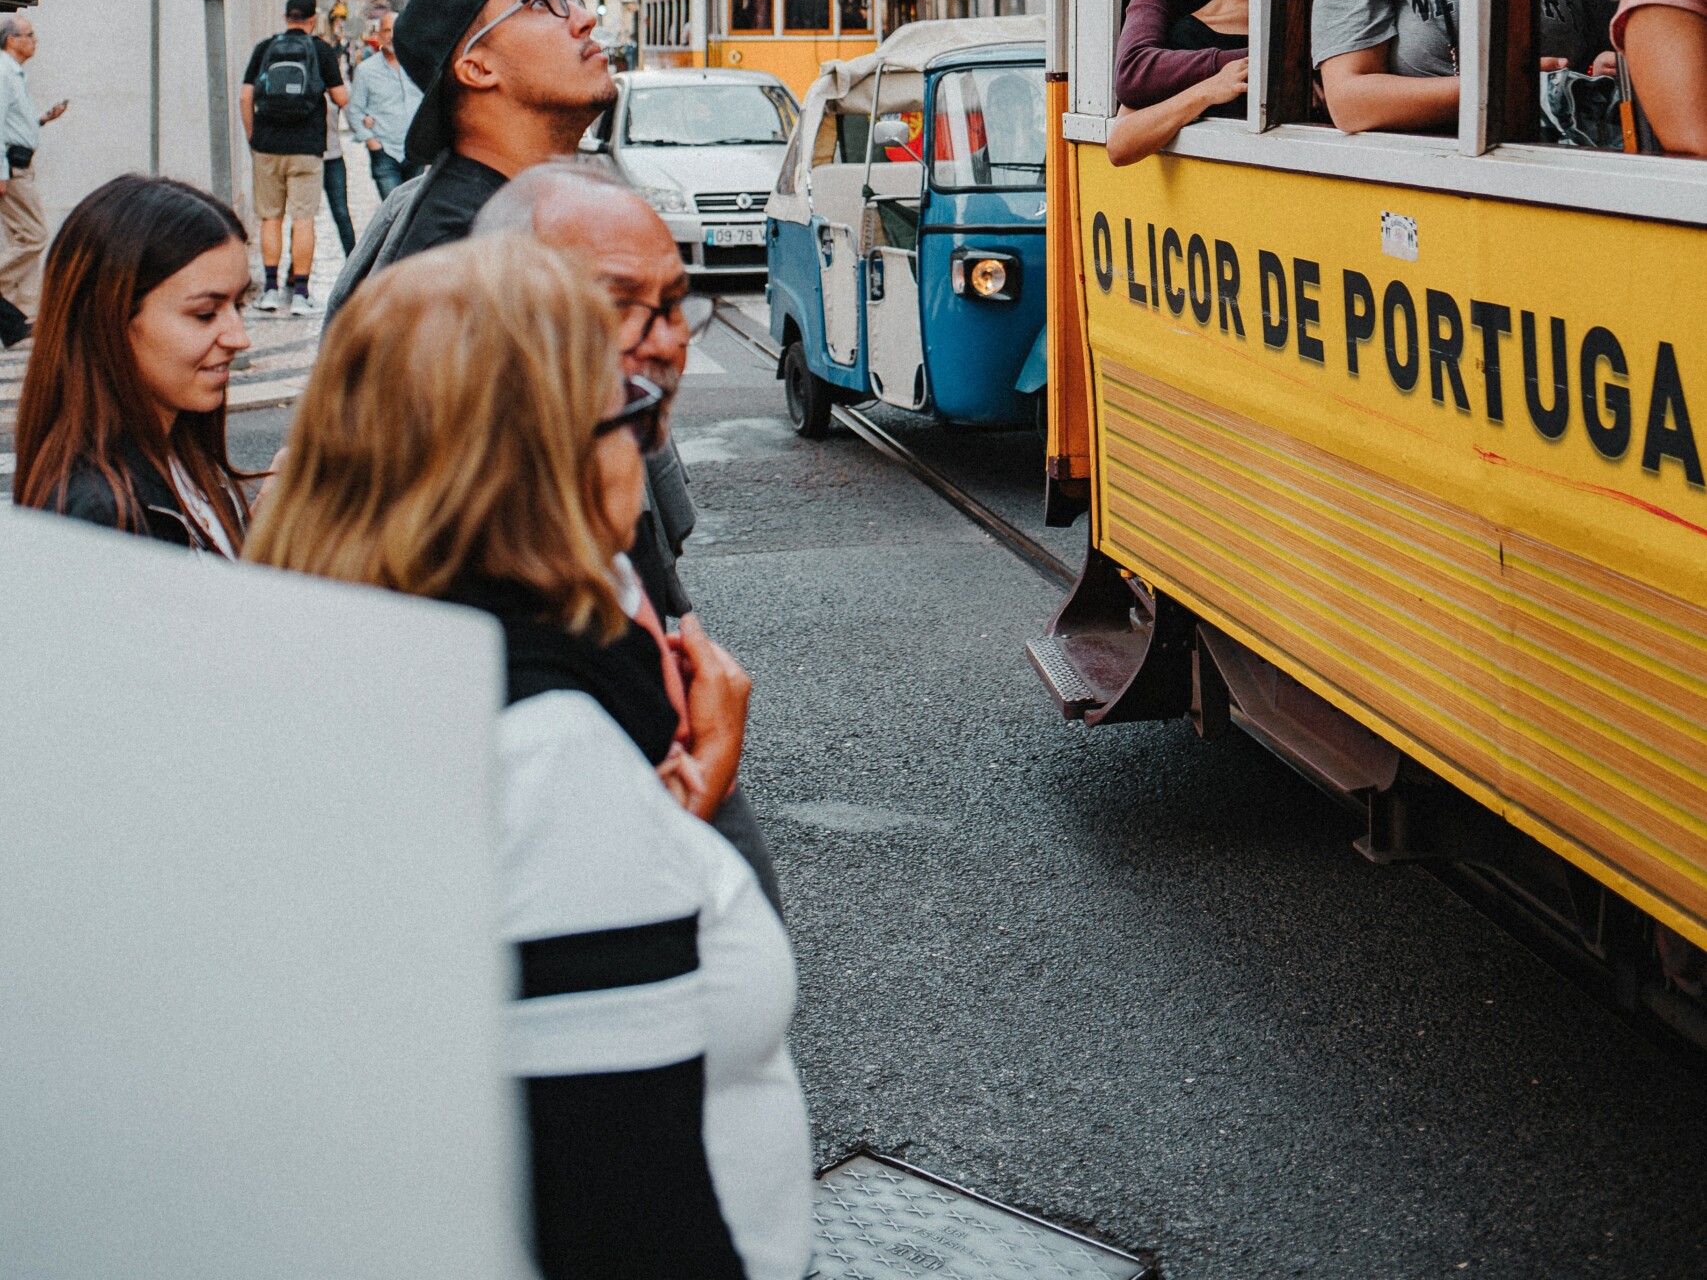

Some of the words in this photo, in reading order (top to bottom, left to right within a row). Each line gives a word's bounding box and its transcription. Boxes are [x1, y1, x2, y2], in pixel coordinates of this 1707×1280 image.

[1092, 210, 1113, 293] O
[1124, 217, 1247, 338] LICOR
[1258, 248, 1326, 365] DE
[1342, 268, 1707, 489] PORTUGA
